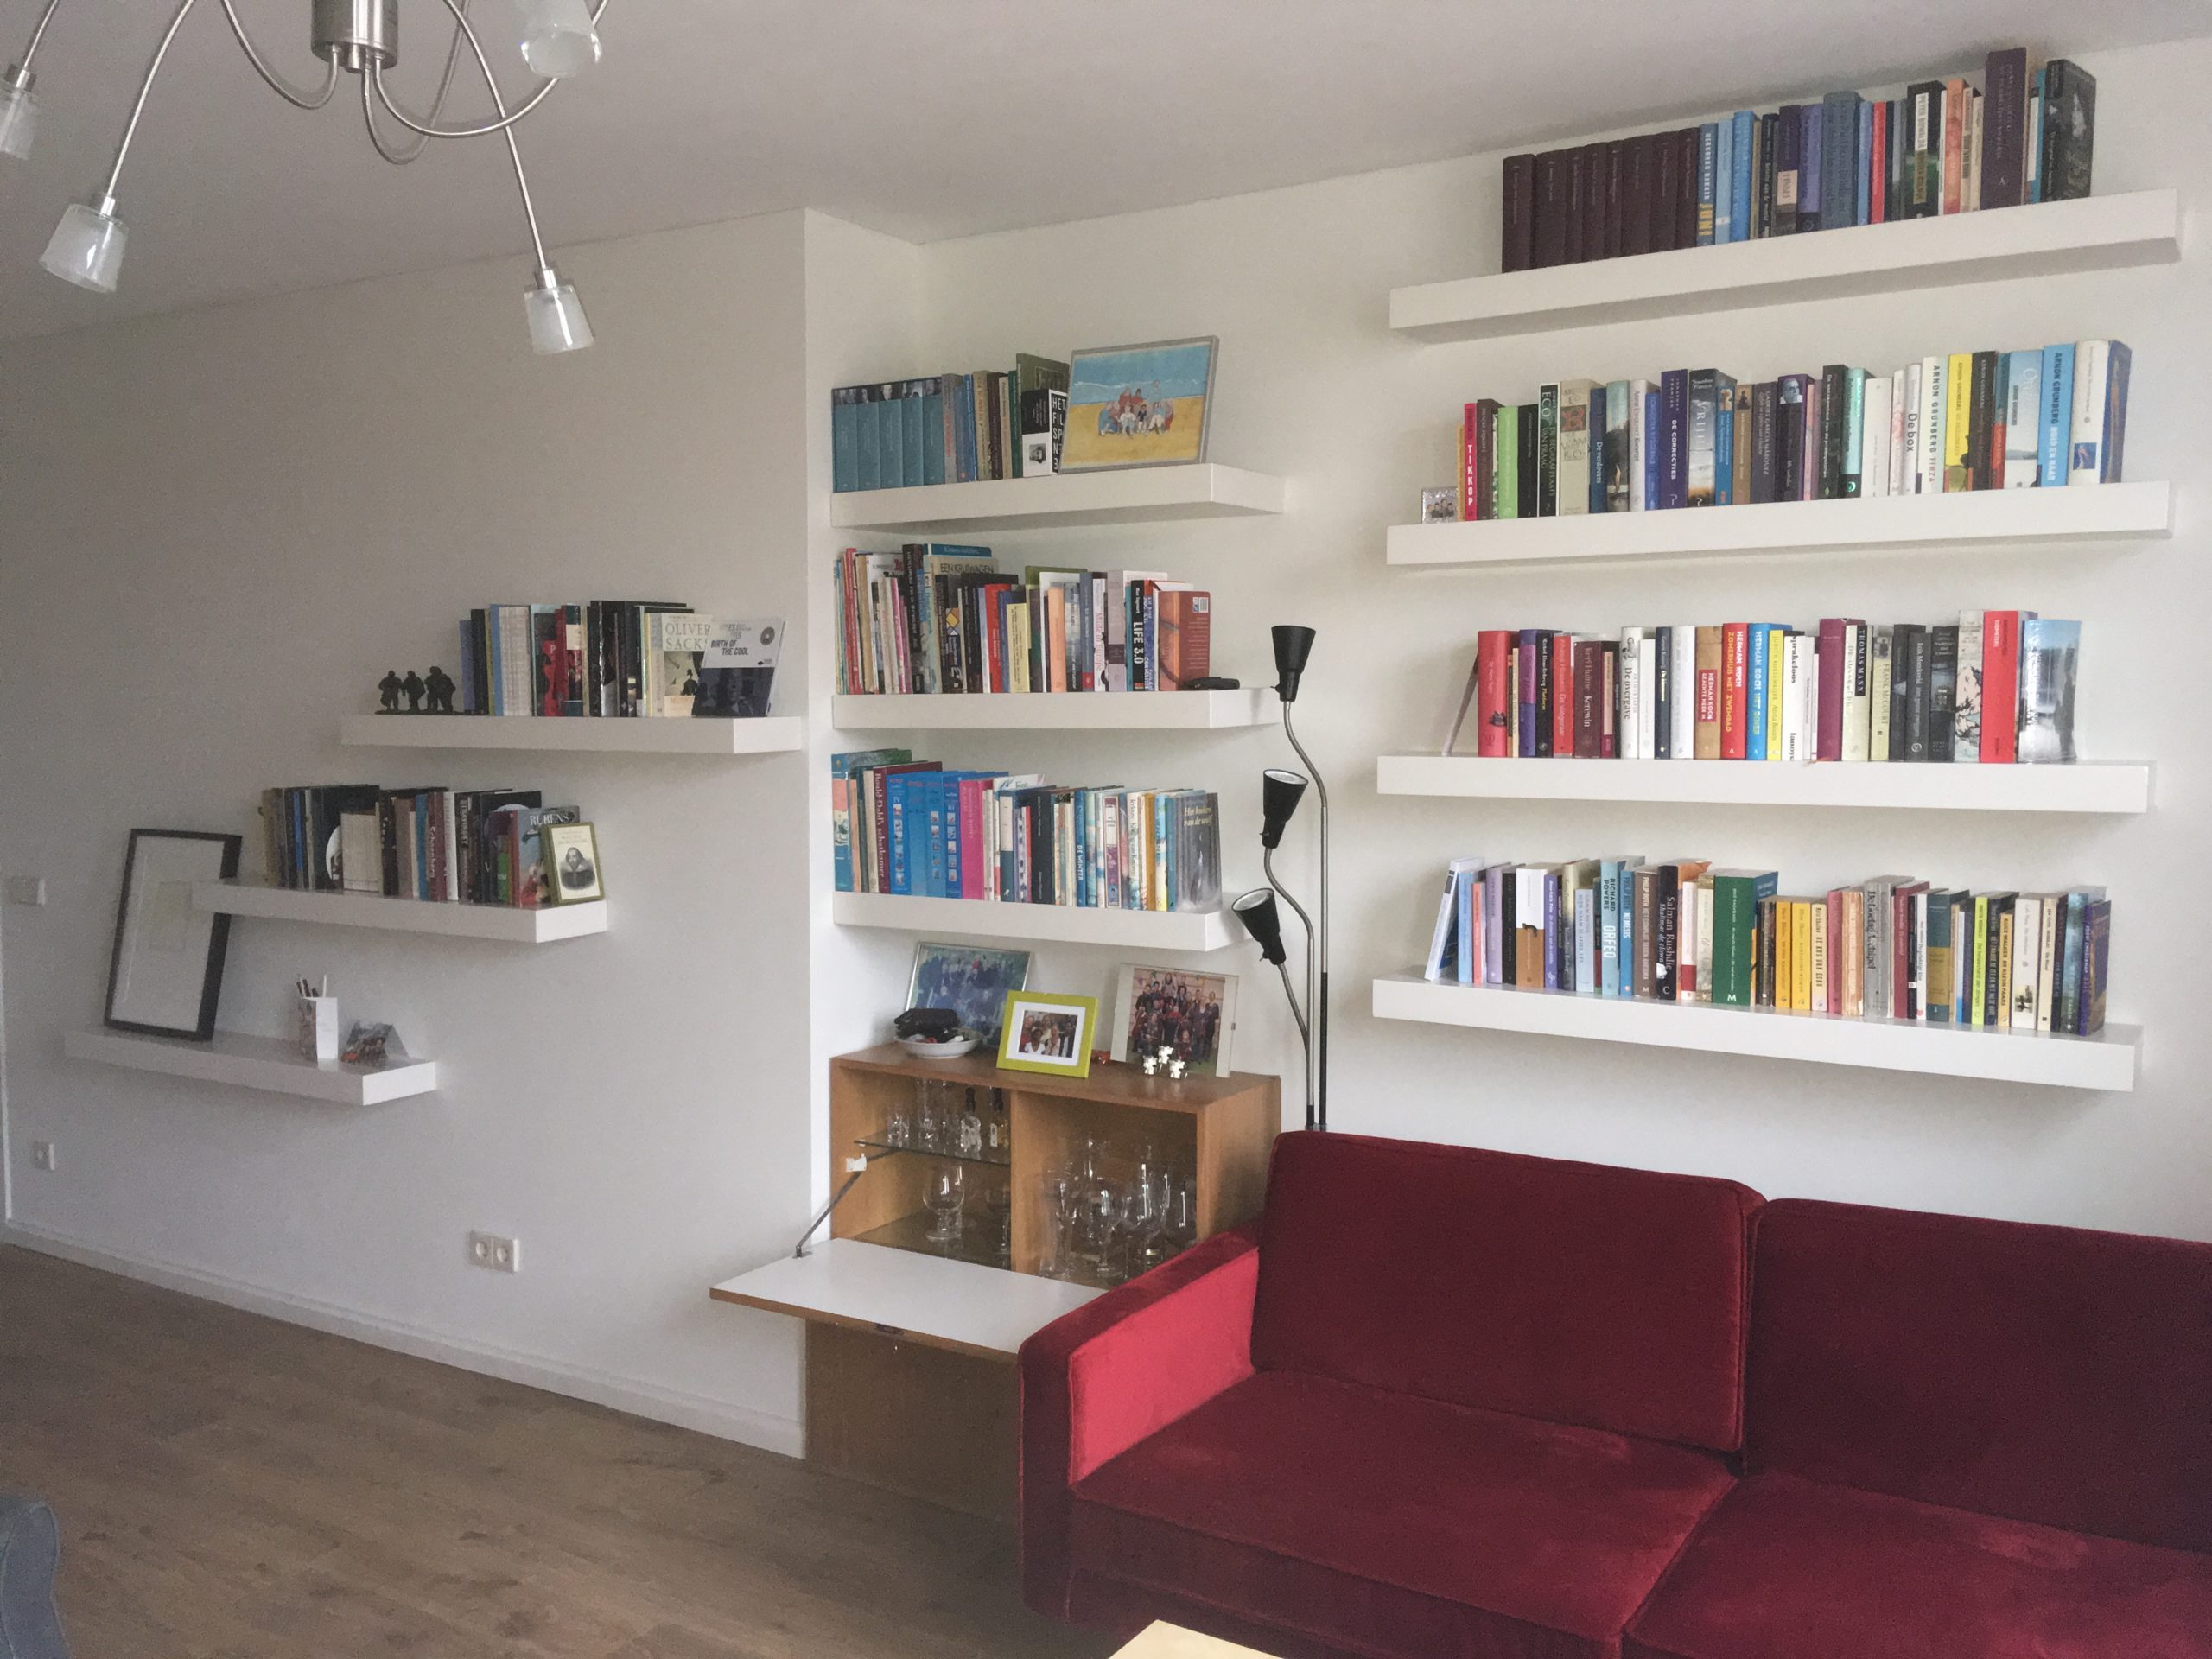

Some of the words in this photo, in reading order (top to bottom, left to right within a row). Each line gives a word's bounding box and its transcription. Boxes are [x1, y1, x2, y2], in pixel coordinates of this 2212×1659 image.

[2054, 352, 2063, 379] ARNON
[1932, 365, 1941, 397] ARNON
[1541, 391, 1552, 417] ECO
[2051, 381, 2061, 424] GRUNBERG
[1671, 419, 1677, 430] DE
[1908, 413, 1917, 429] De
[1929, 401, 1939, 454] GRUNBERG
[1907, 430, 1917, 453] box
[1928, 456, 1936, 483] TIRZA
[665, 622, 711, 636] OLIVER
[1133, 622, 1144, 644] LIFE
[734, 647, 748, 656] COOL
[1133, 647, 1144, 664] 3.0
[1790, 635, 1799, 683] sprakeloos
[1624, 667, 1633, 680] De
[1559, 694, 1566, 703] De
[1623, 681, 1631, 720] overgave
[1583, 696, 1592, 727] Kerewin
[530, 812, 569, 826] RUBENS
[1184, 806, 1194, 817] Het
[1195, 817, 1201, 825] de
[1077, 844, 1083, 853] DE
[1666, 895, 1675, 930] Salman
[1604, 925, 1616, 958] ORFEO
[1665, 932, 1675, 969] Rushdie
